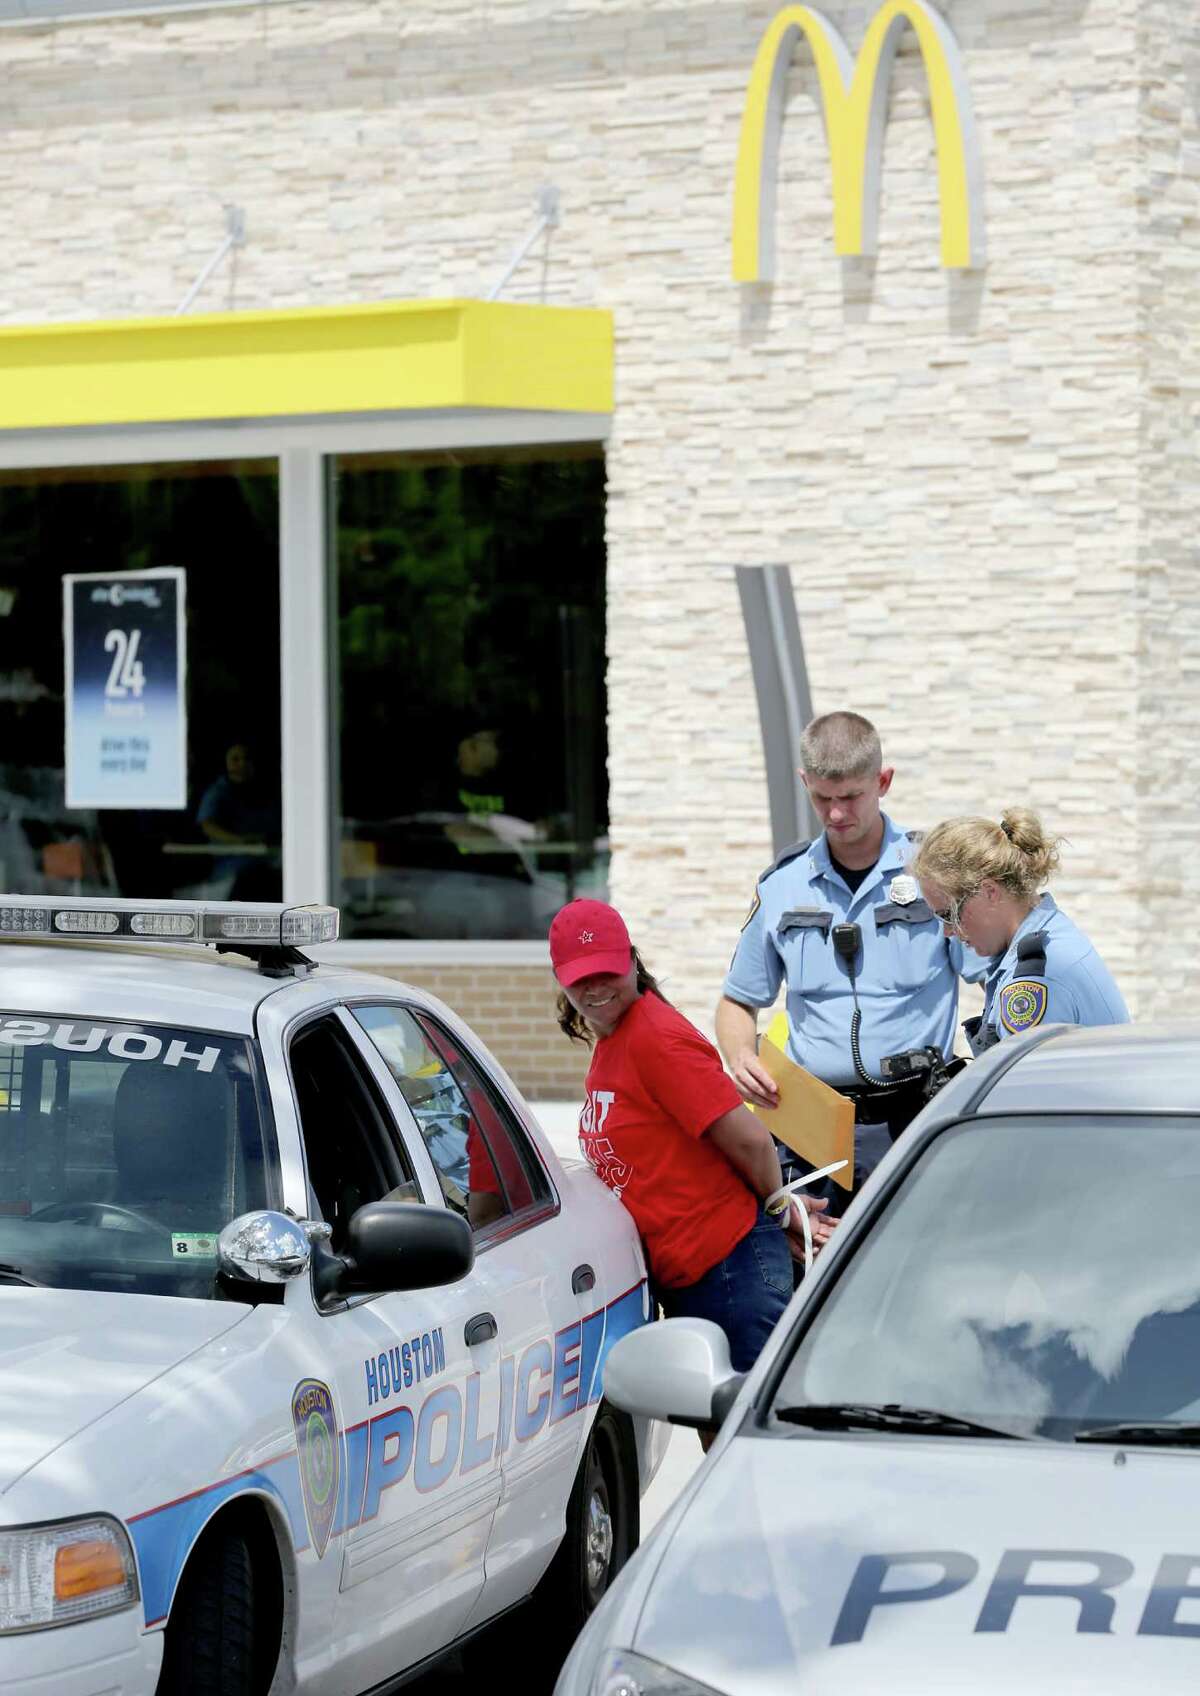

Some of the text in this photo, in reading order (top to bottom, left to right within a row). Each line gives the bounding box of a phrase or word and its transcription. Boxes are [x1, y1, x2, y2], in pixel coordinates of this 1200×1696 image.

[104, 628, 146, 698] 24
[176, 1242, 188, 1253] 8
[364, 1327, 446, 1406] HOUSTON
[297, 1388, 327, 1418] HOUSTON
[360, 1319, 583, 1525] POLICE
